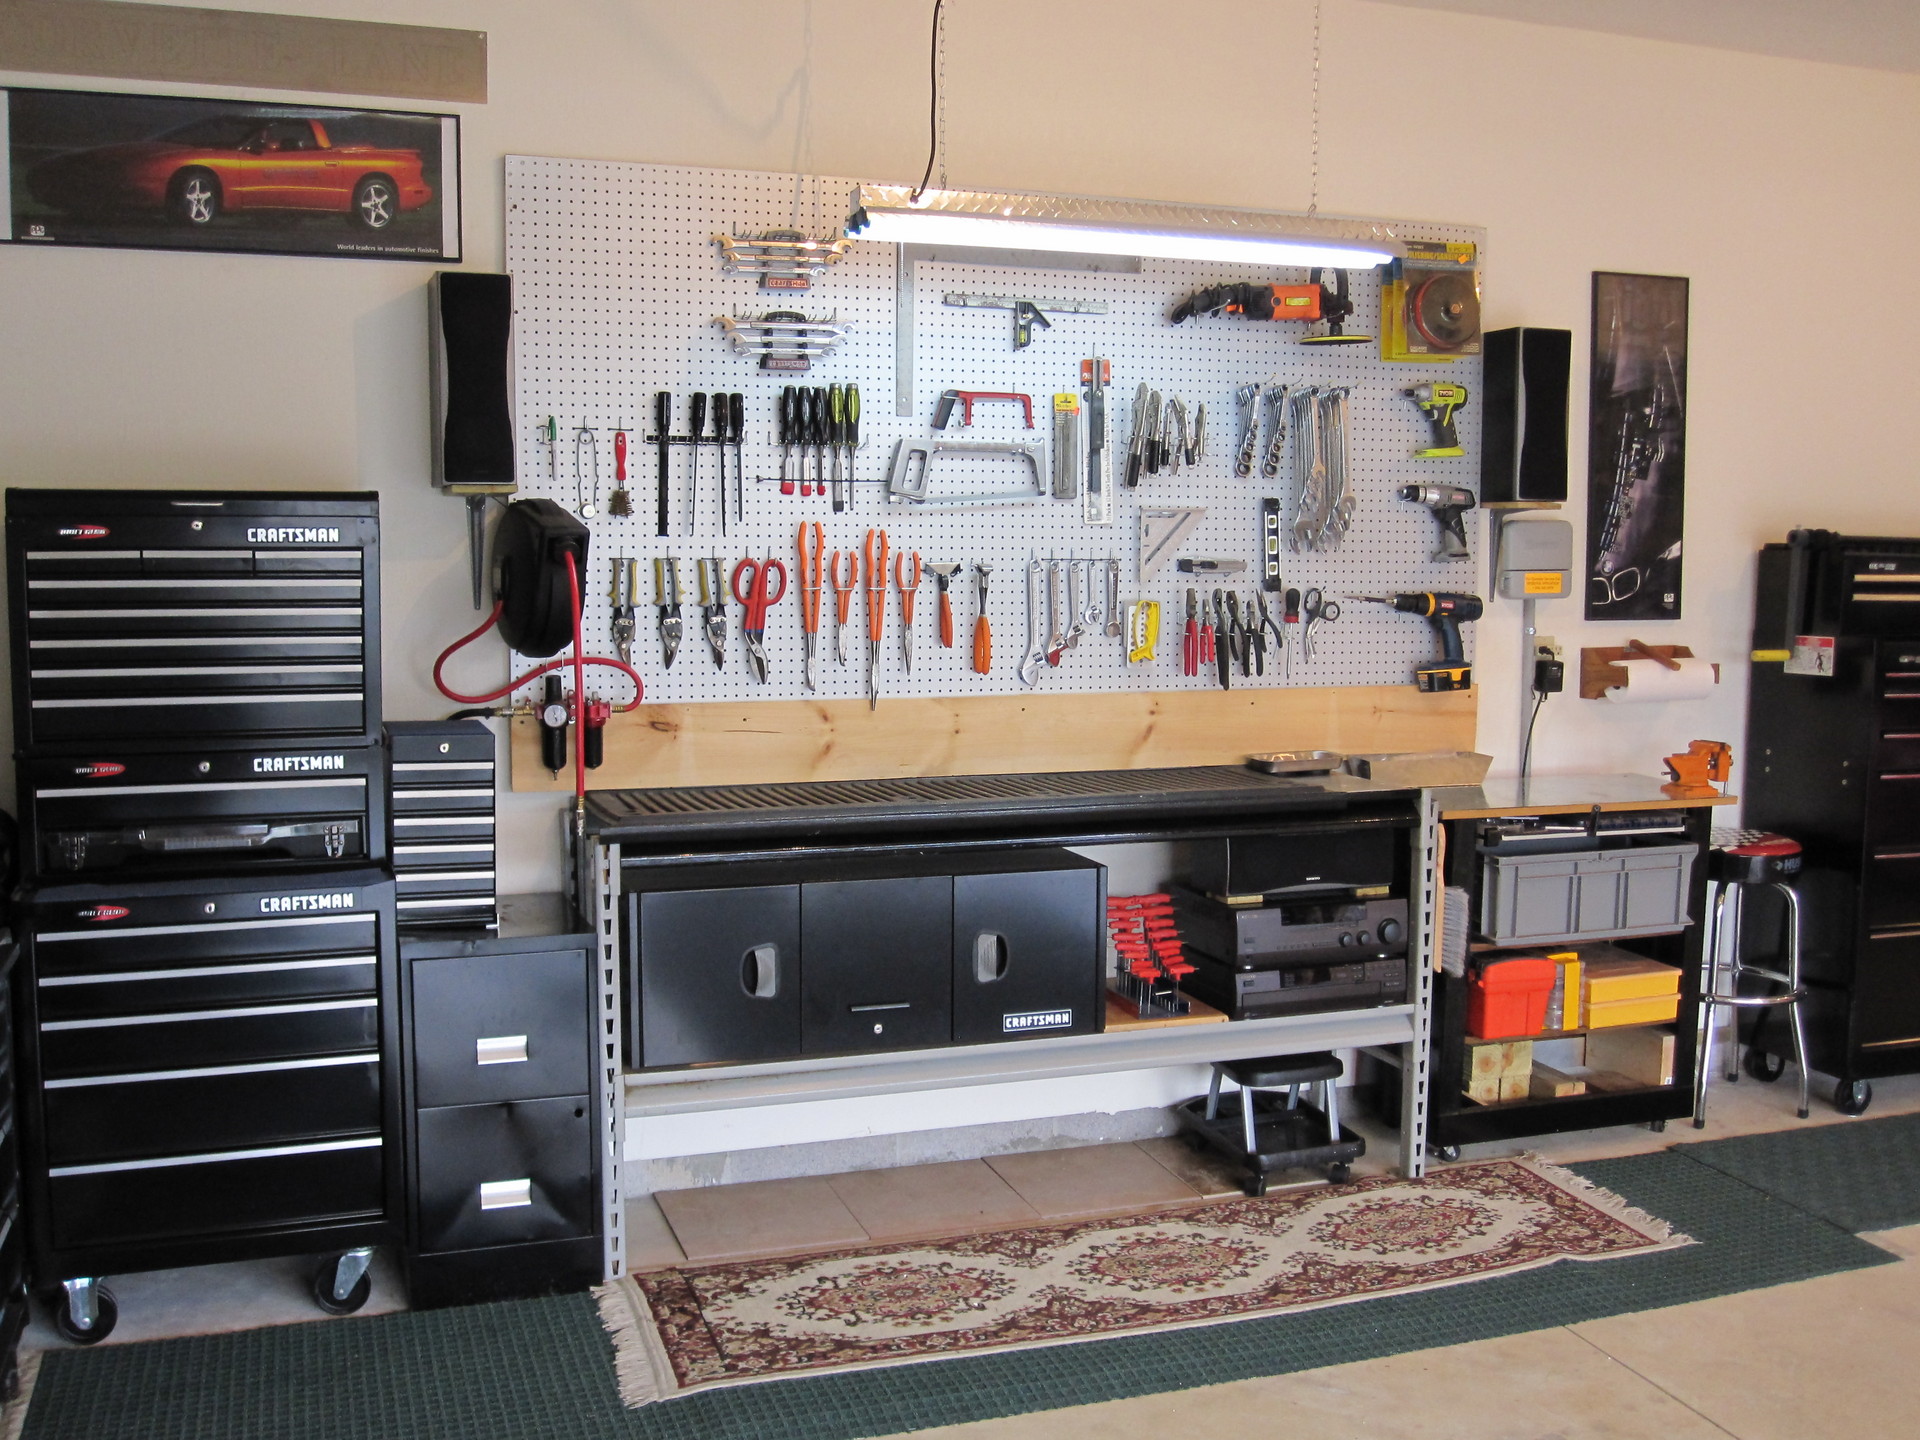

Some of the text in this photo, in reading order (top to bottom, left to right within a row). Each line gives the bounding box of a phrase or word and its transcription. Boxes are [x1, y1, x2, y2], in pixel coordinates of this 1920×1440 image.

[247, 528, 339, 542] CRAFTSMAN
[253, 755, 344, 772] CRAFTSMAN
[260, 892, 354, 912] CRAFTSMAN
[1005, 1012, 1070, 1028] CRAFTSMAN
